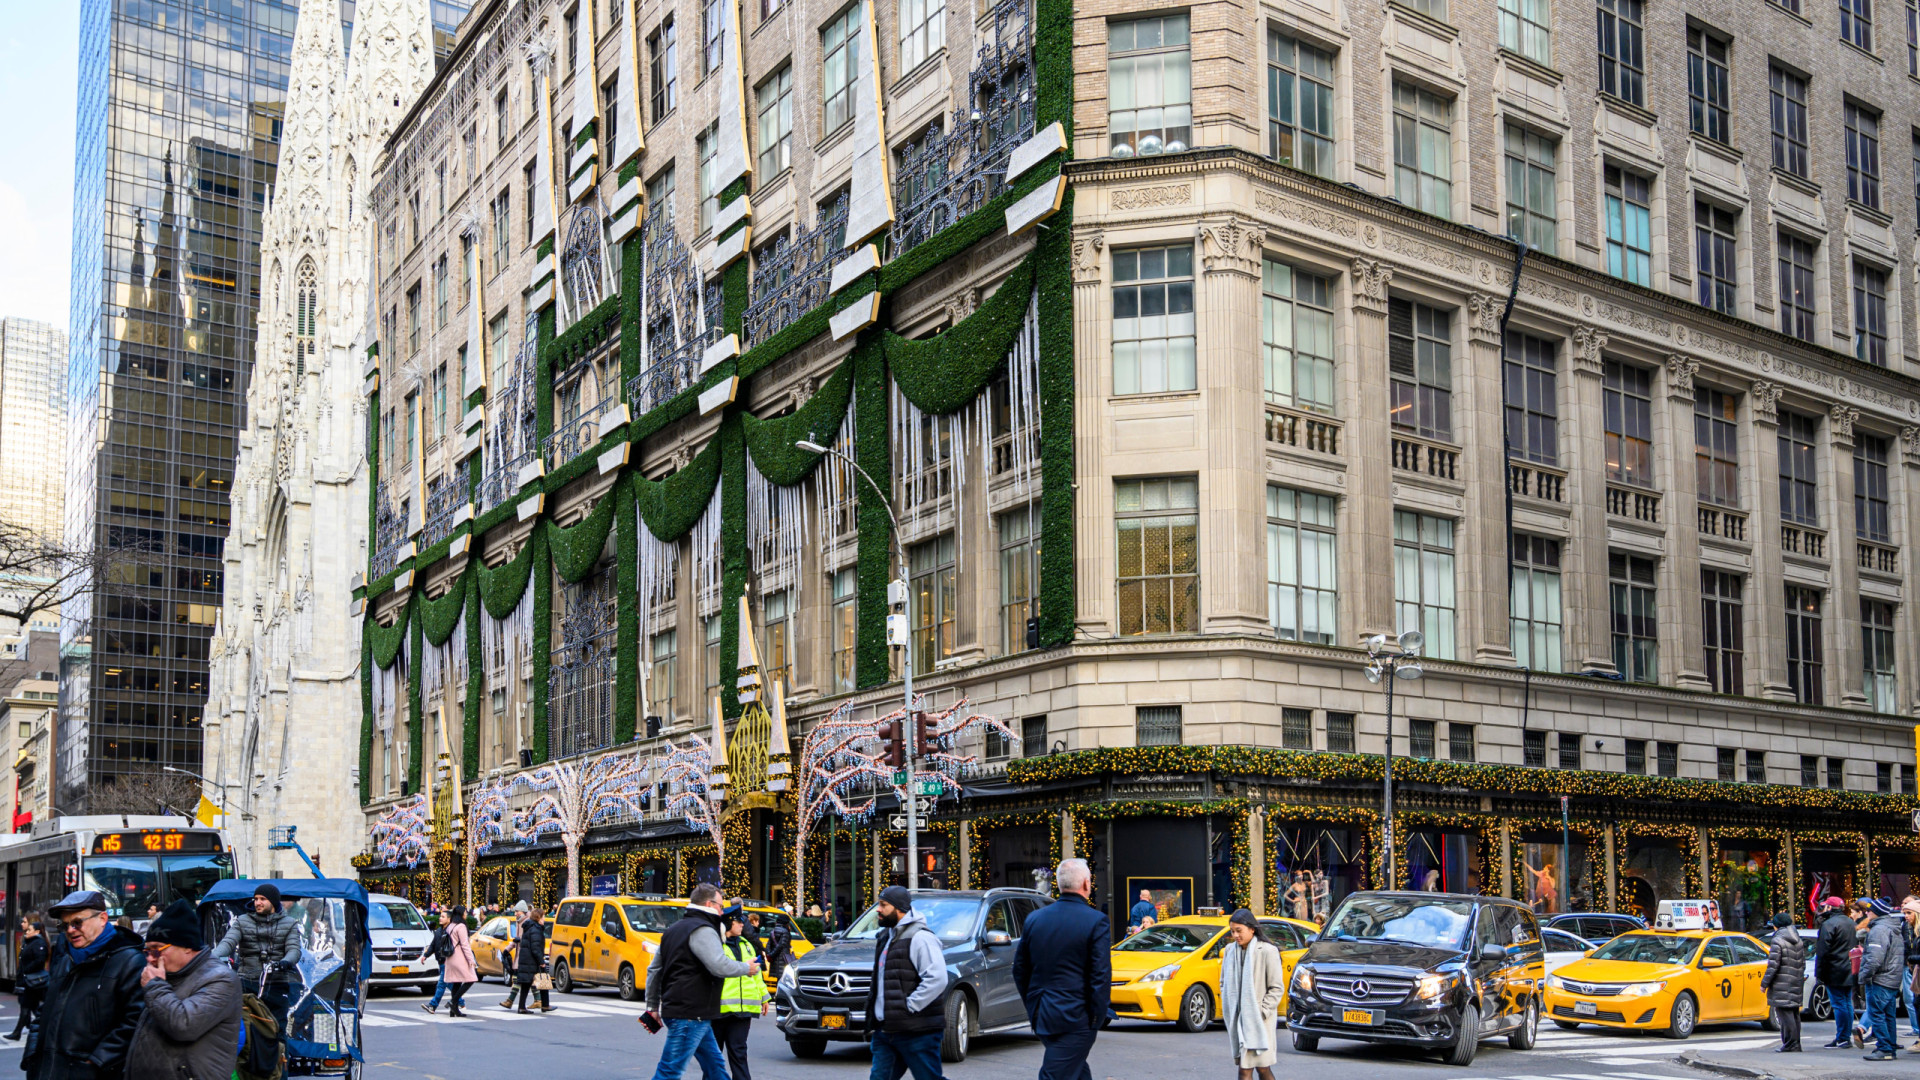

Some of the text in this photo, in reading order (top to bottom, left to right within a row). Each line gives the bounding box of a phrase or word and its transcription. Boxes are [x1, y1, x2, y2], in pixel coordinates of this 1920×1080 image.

[923, 784, 926, 793] E
[928, 784, 935, 792] 49
[102, 834, 183, 851] M5 42 ST
